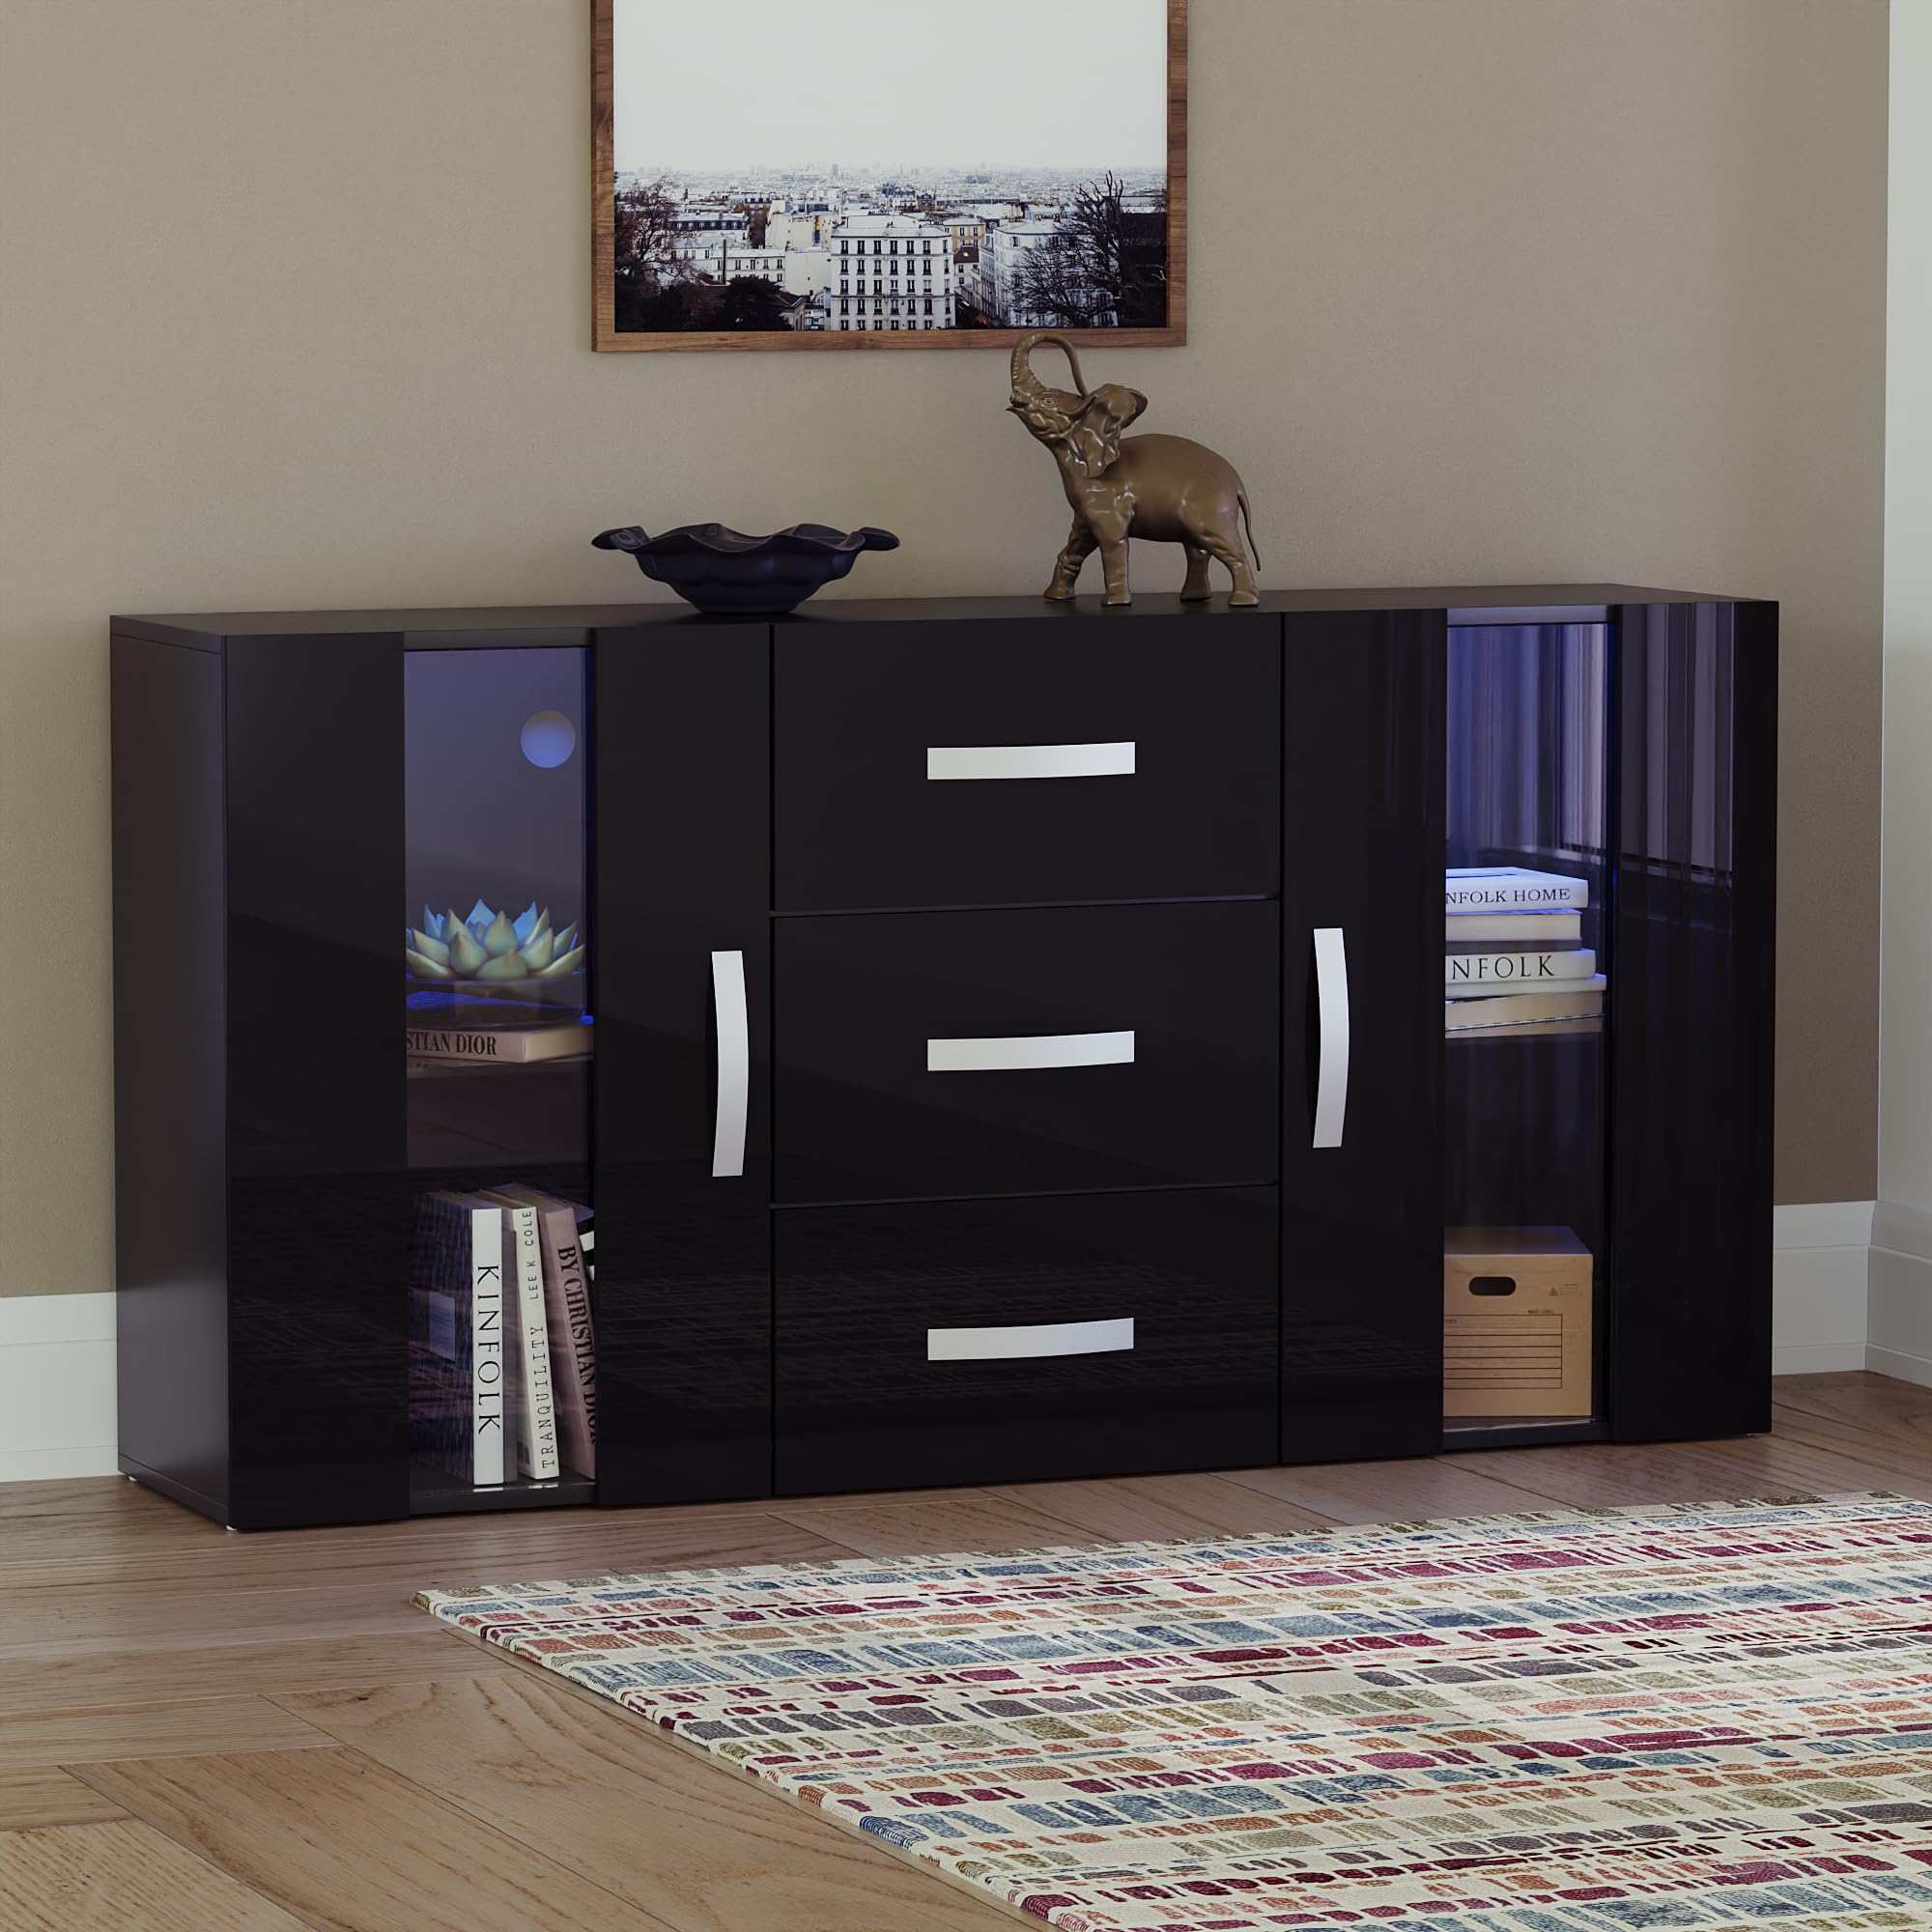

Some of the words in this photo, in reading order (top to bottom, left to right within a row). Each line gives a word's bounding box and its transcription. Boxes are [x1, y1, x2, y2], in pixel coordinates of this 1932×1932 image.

[1445, 890, 1507, 904] NFOLK
[1514, 888, 1571, 902] HOME
[1452, 954, 1555, 980] NFOLK
[455, 1034, 497, 1056] DIOR
[522, 1210, 534, 1246] COLE
[557, 1244, 580, 1272] BY
[526, 1275, 539, 1300] LEE
[563, 1277, 595, 1386] CHRISTIAN
[477, 1264, 500, 1435] KINFOLK
[530, 1325, 555, 1469] TRANQUILITY
